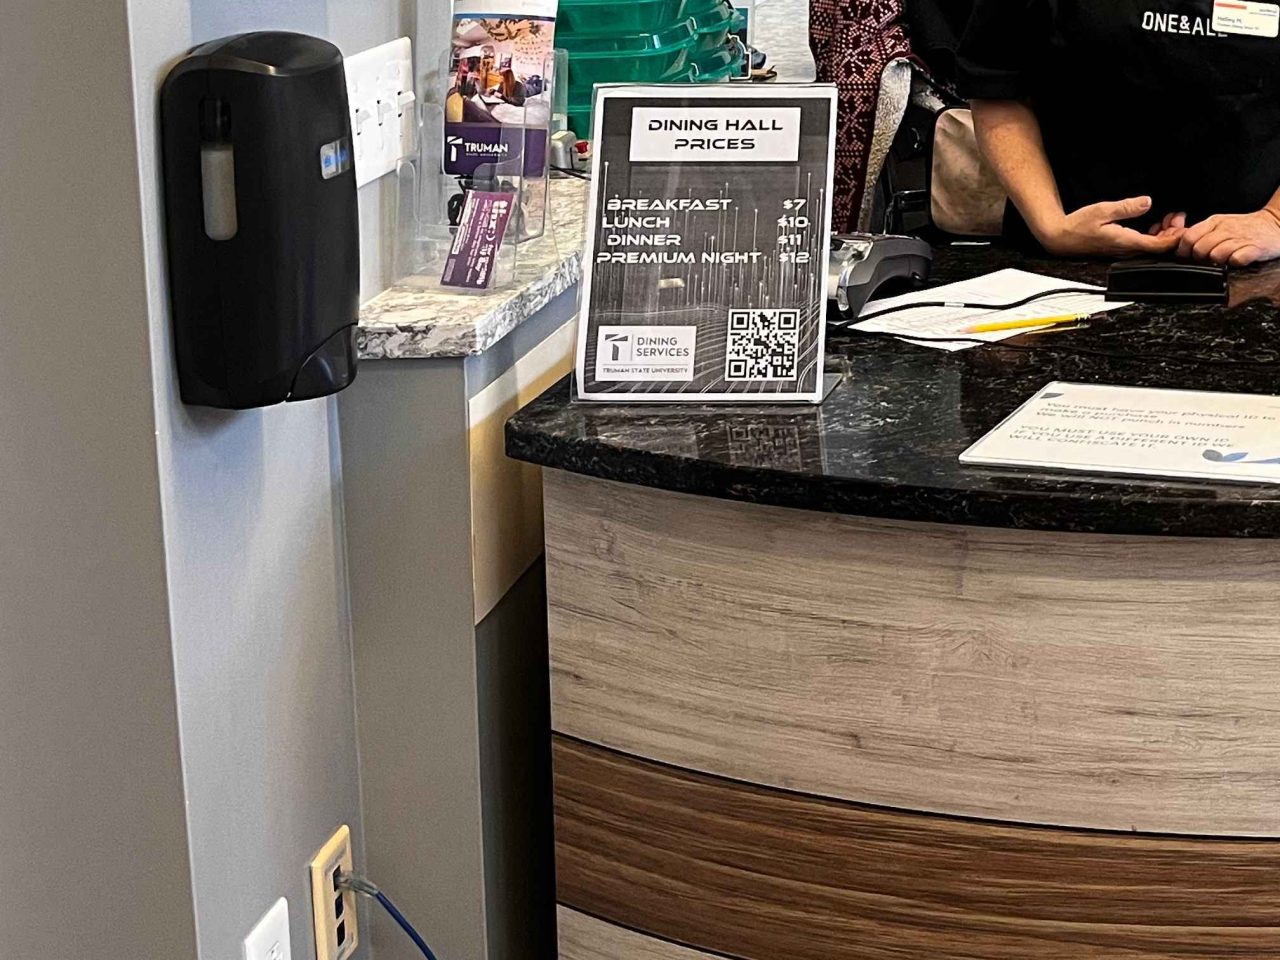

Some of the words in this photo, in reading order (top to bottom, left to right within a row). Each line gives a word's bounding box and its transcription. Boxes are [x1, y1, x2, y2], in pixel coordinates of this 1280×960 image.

[1142, 11, 1228, 37] ONE&AL
[648, 119, 718, 131] DINING
[725, 119, 783, 131] HALL
[465, 143, 508, 153] TRUMAN
[674, 138, 755, 150] PRICES
[607, 198, 732, 210] BREAKFAST
[782, 198, 807, 210] $7
[602, 217, 670, 228] LUNCH
[777, 216, 809, 228] $10
[607, 234, 682, 246] DINNER
[777, 234, 802, 246] $11
[596, 252, 695, 264] PREMIUM
[701, 252, 762, 263] NIGHT
[779, 252, 810, 263] $12
[637, 337, 677, 346] DINING
[636, 348, 689, 357] SERVICES
